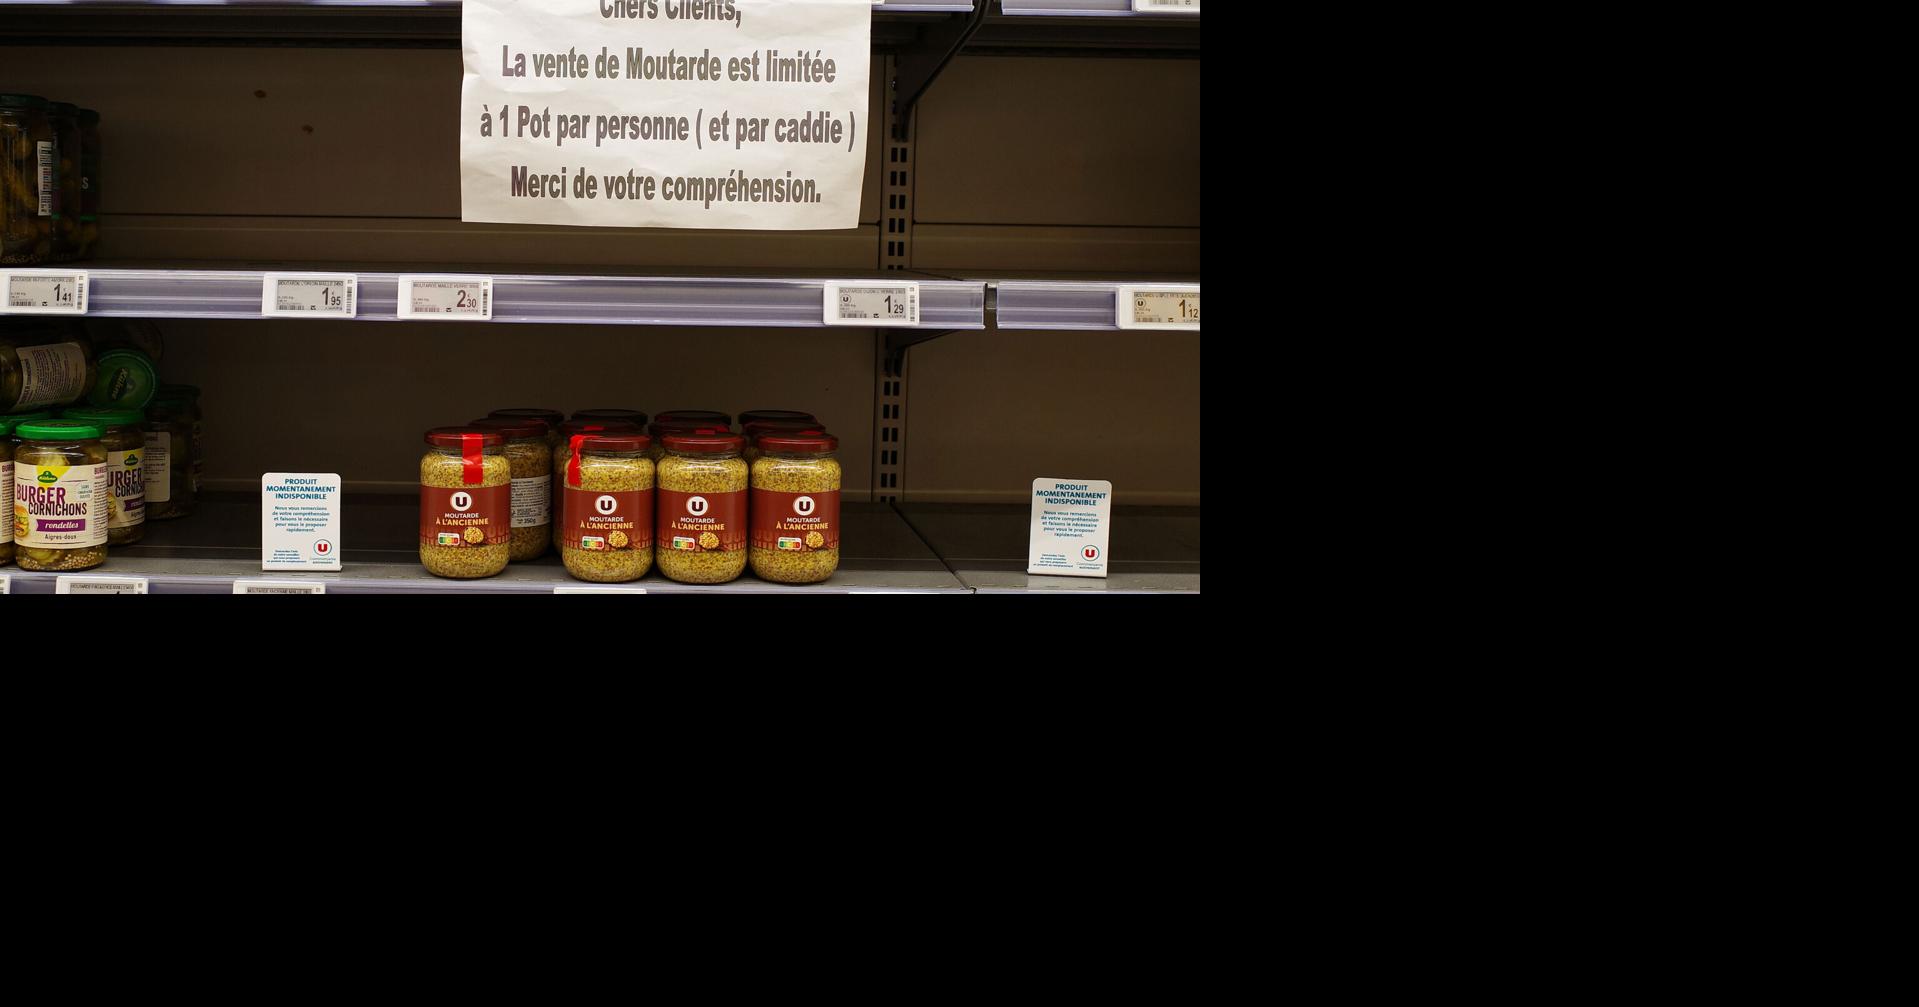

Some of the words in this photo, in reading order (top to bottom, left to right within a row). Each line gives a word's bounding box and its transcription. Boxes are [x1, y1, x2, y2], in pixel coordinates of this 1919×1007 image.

[600, 0, 658, 19] Chers
[665, 0, 741, 28] Clients,
[502, 45, 526, 77] La
[533, 46, 588, 79] vente
[595, 47, 620, 79] de
[626, 47, 721, 81] Moutarde
[728, 50, 760, 82] est
[766, 50, 836, 83] limitée
[480, 104, 492, 137] à
[500, 105, 508, 137] 1
[517, 106, 550, 138] Pot
[557, 114, 590, 146] par
[596, 115, 689, 147] personne
[709, 110, 729, 142] et
[736, 117, 769, 150] par
[774, 111, 842, 143] caddie
[511, 166, 566, 198] Merci
[573, 167, 597, 199] de
[604, 168, 655, 200] votre
[661, 169, 821, 209] compréhension.
[54, 283, 61, 302] 1
[62, 292, 72, 302] 41
[322, 287, 329, 306] 1
[330, 296, 341, 306] 95
[456, 289, 466, 308] 2
[466, 298, 477, 308] 30
[884, 295, 891, 314] 1
[893, 304, 904, 314] 29
[1178, 299, 1186, 318] 1
[1188, 308, 1199, 318] 12
[16, 483, 66, 504] BURGER
[1036, 490, 1107, 499] MOMENTANEMENT
[456, 497, 468, 507] U
[600, 500, 613, 511] U
[692, 501, 704, 512] U
[799, 501, 811, 512] U
[1045, 498, 1097, 506] INDISPONIBLE
[28, 502, 87, 516] CORNICHONS
[45, 521, 79, 529] rondelles
[442, 518, 489, 526] L'ANCIENNE
[587, 522, 634, 530] L'ANCIENNE
[678, 523, 725, 531] L'ANCIENNE
[783, 522, 829, 531] L'ANCIENNE
[318, 544, 328, 552] U
[1085, 549, 1095, 557] U
